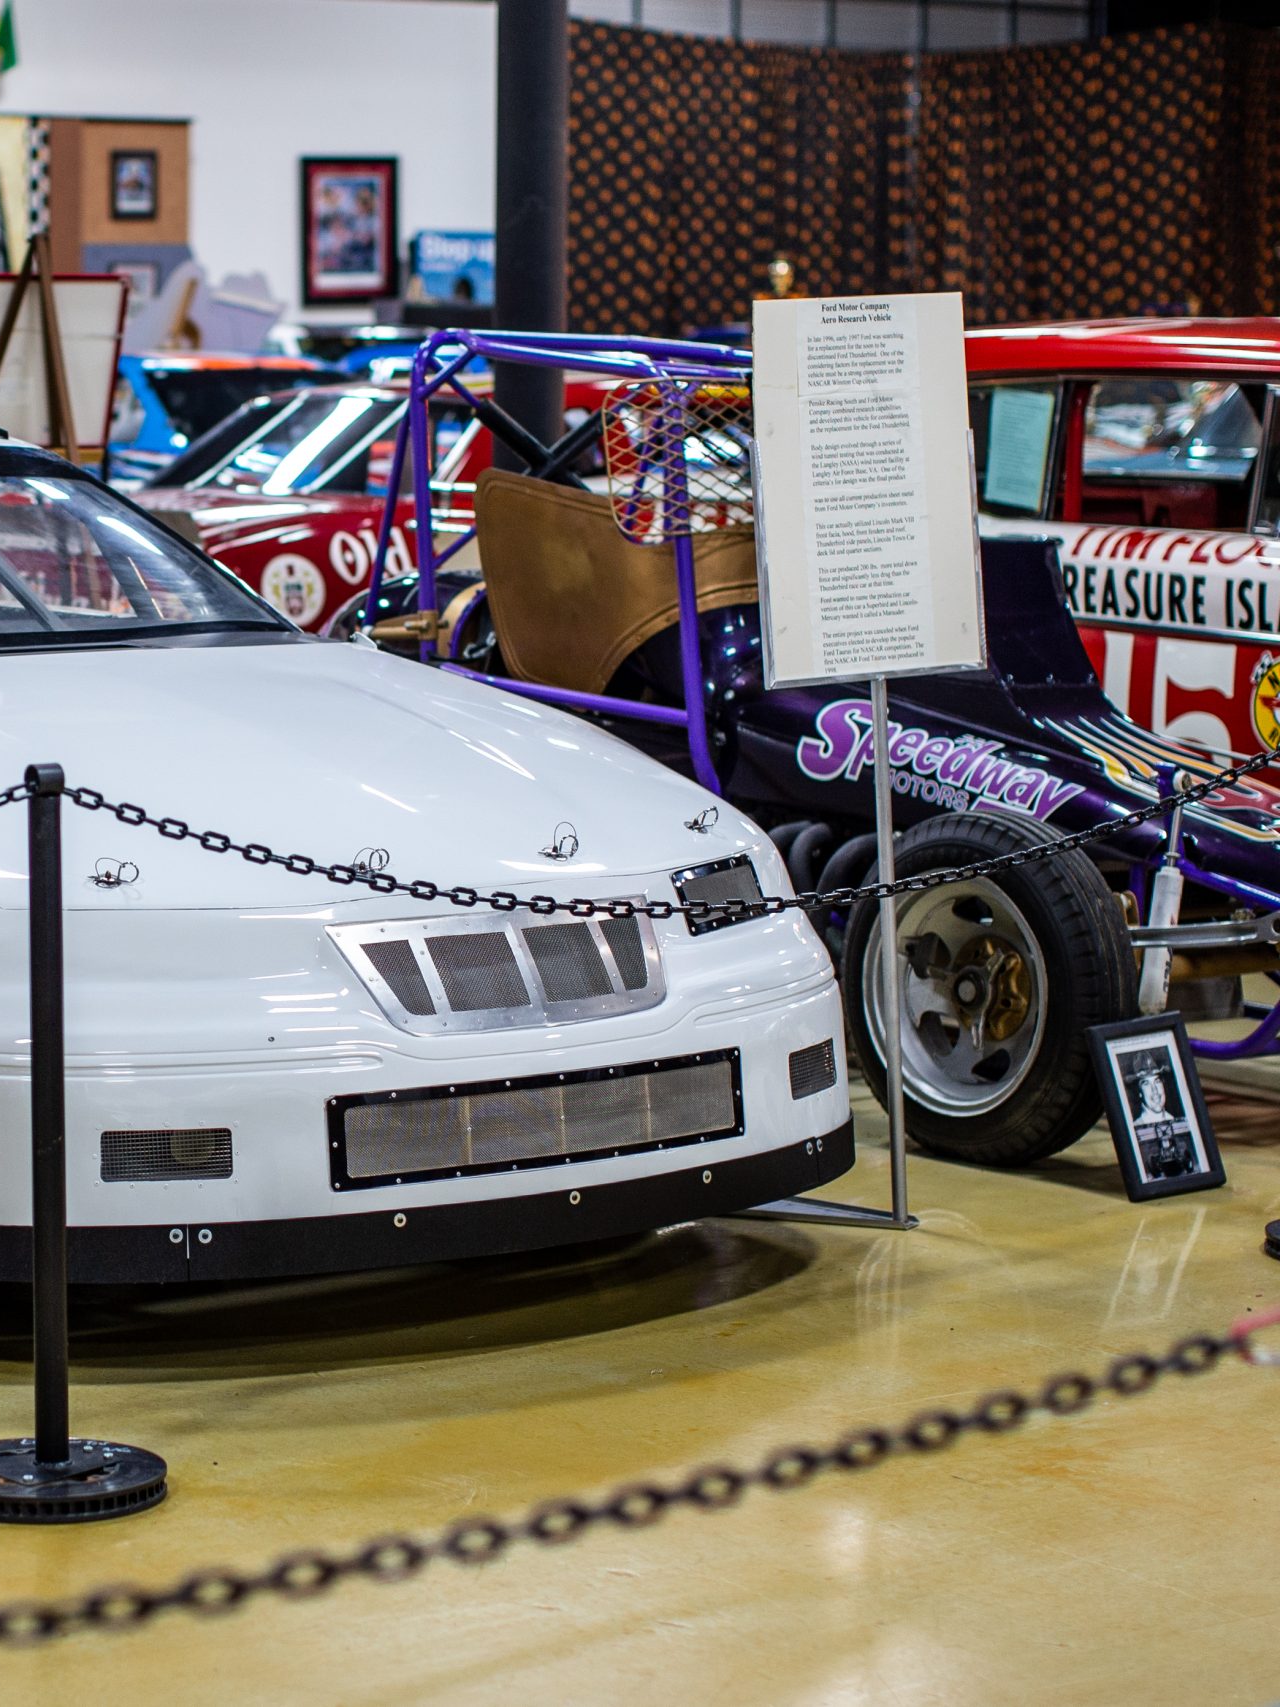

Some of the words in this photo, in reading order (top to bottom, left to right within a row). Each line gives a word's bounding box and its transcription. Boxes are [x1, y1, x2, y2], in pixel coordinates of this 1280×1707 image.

[822, 304, 837, 312] Ford
[838, 303, 858, 311] Motor
[860, 303, 890, 312] Company
[821, 316, 836, 324] Aero
[838, 315, 866, 323] Research
[868, 314, 891, 322] Vehicle
[1072, 526, 1166, 560] TIM
[1063, 565, 1206, 624] REASURE
[1226, 578, 1280, 631] ISL
[860, 645, 883, 653] NASCAR
[797, 699, 1086, 822] Speedway
